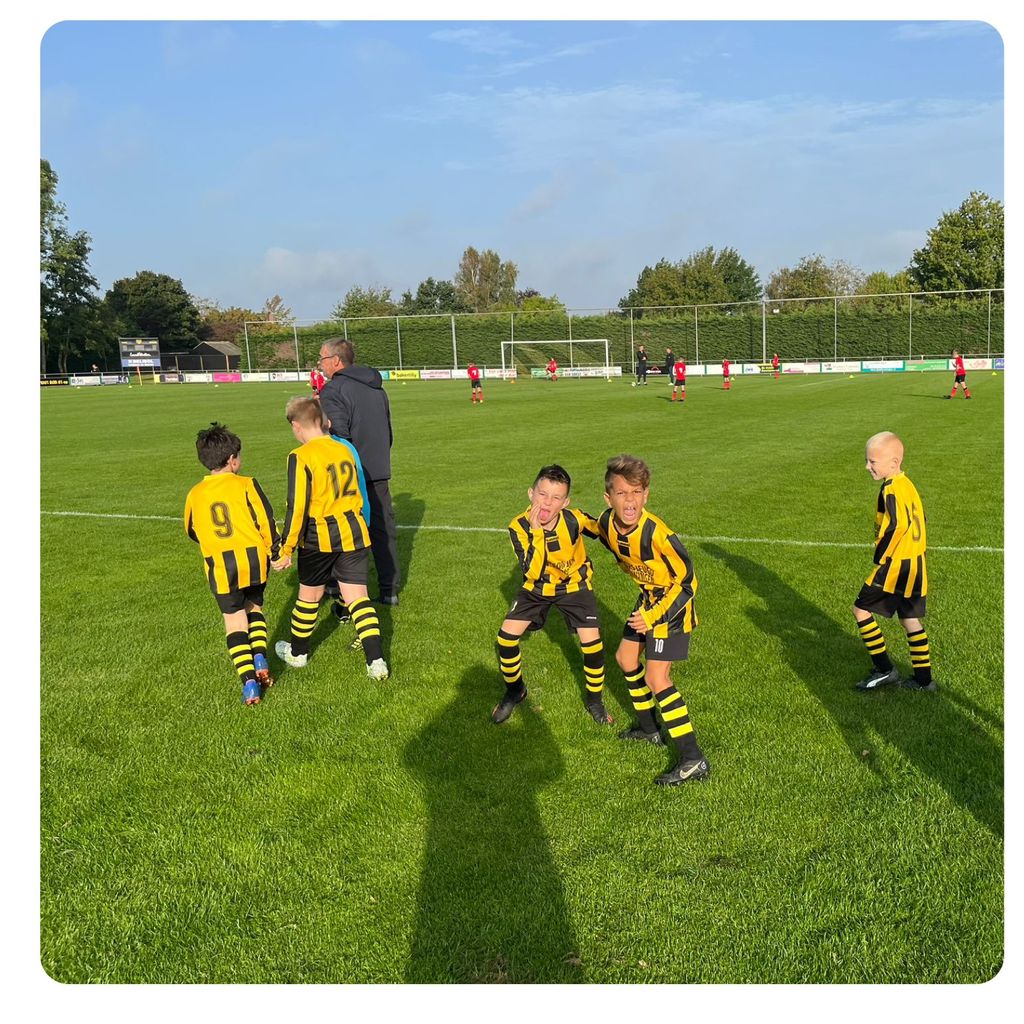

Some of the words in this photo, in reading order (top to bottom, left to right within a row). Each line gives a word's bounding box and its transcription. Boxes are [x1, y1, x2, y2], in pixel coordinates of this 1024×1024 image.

[327, 460, 357, 500] 12
[210, 501, 233, 539] 9
[654, 639, 664, 653] 10
